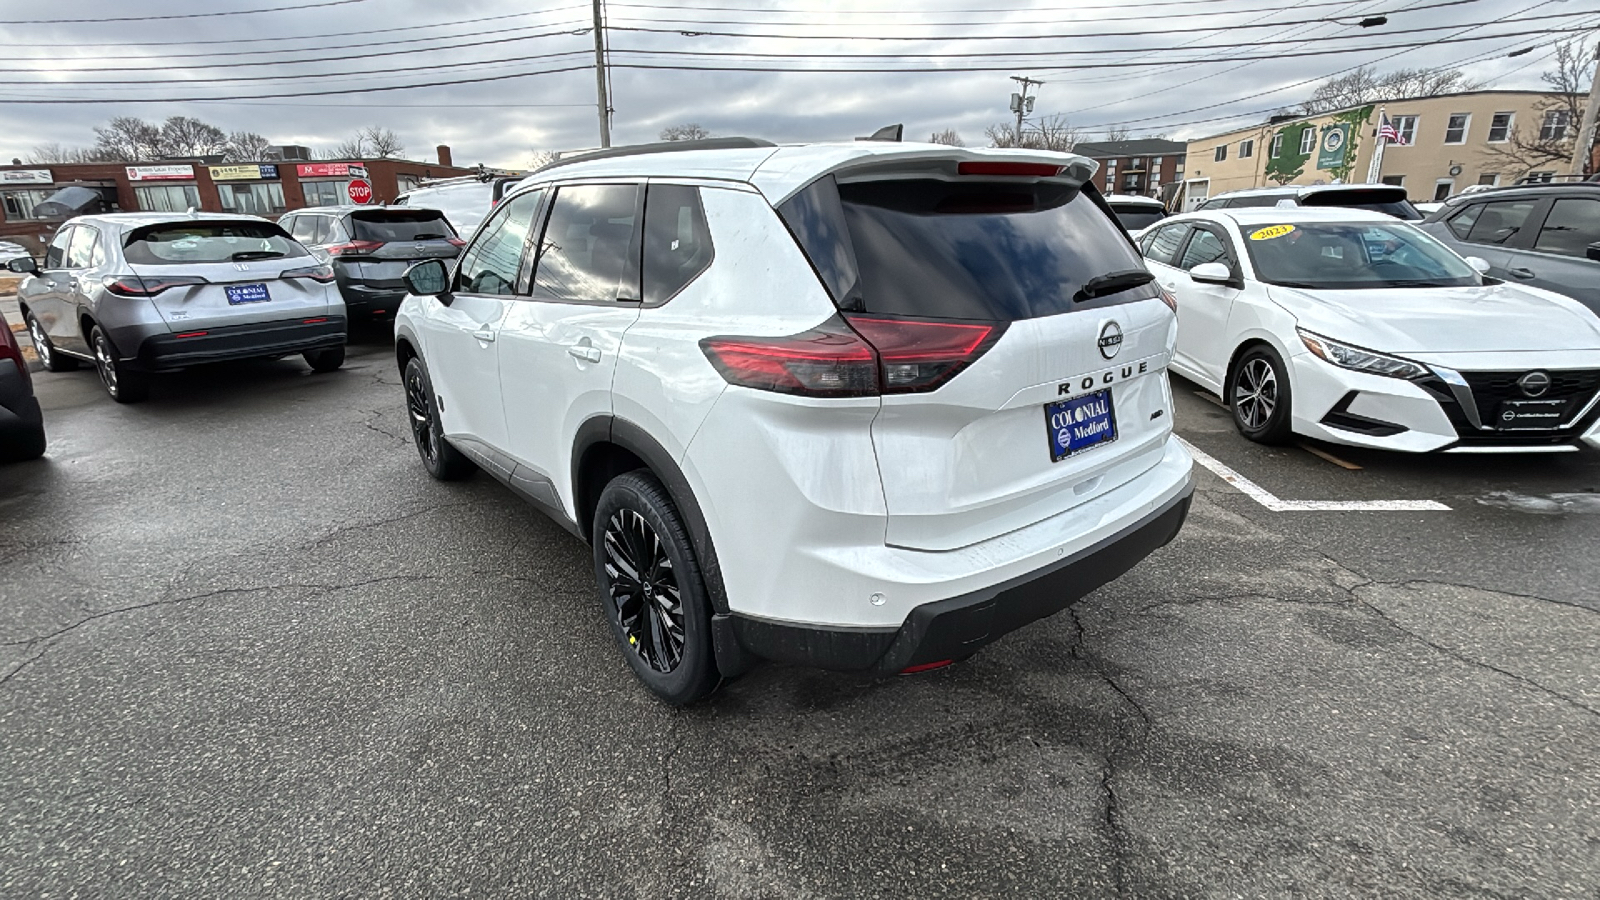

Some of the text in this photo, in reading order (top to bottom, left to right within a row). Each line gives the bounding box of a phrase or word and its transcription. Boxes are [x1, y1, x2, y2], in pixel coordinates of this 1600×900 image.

[349, 187, 370, 198] STOP
[1258, 226, 1288, 239] 2023
[227, 287, 266, 296] COLONIAL
[1057, 361, 1148, 396] ROGUE
[1051, 399, 1109, 430] COLONIAL
[1074, 418, 1109, 441] Medford
